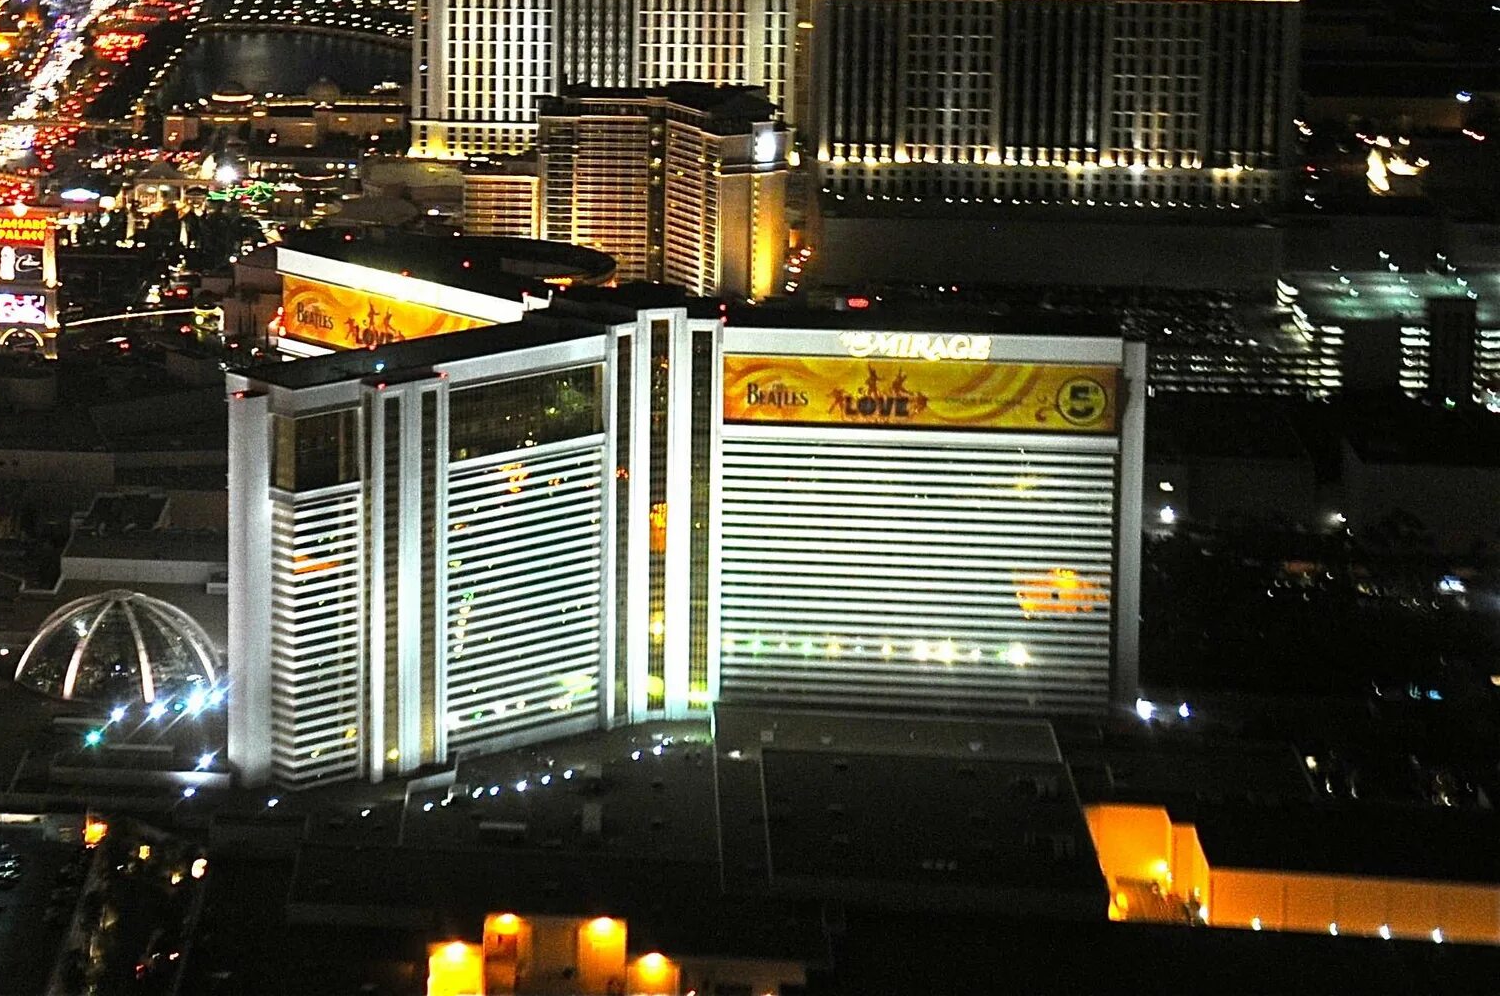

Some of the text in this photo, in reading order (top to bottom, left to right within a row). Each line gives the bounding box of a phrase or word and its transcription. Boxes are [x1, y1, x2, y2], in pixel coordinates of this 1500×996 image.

[848, 331, 992, 361] MIRAGE
[747, 382, 809, 408] BEATLES
[845, 395, 909, 416] LOVE
